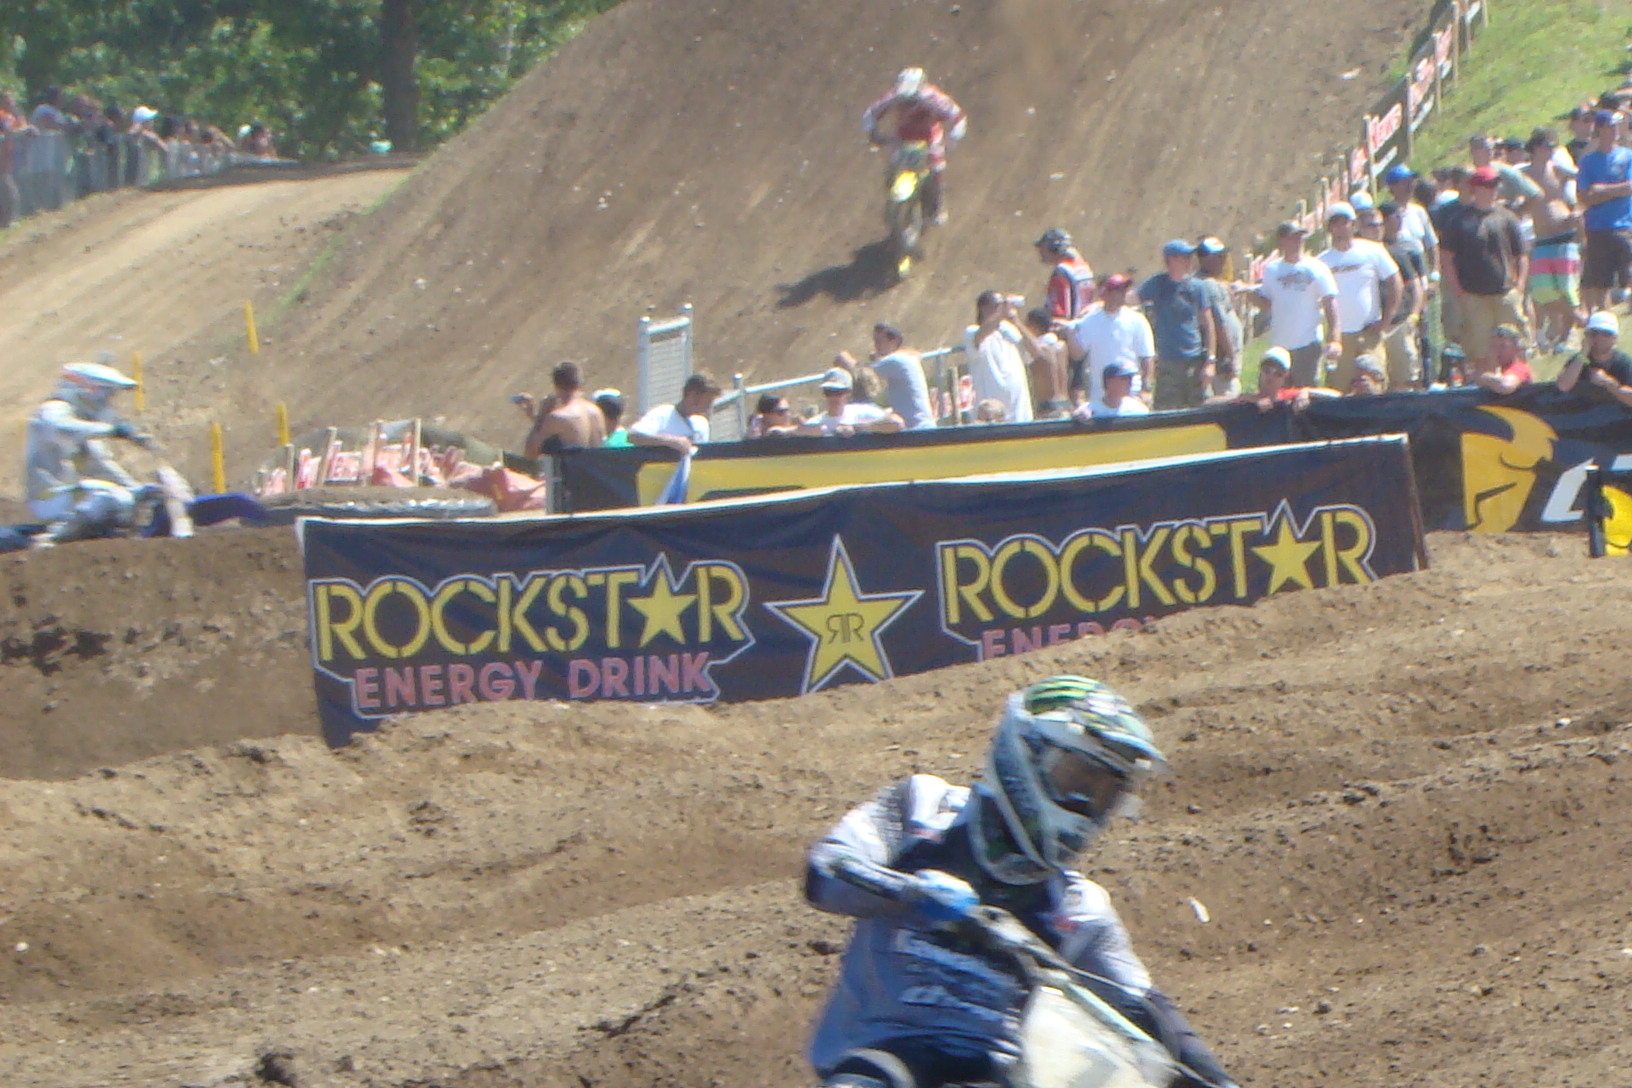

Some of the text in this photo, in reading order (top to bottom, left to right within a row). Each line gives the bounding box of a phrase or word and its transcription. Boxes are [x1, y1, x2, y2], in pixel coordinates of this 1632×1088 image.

[943, 511, 1373, 625] ROCKSTAR
[314, 565, 746, 661] ROCKSTAR
[982, 615, 1158, 659] ENE
[354, 651, 713, 710] ENERGY DRINK
